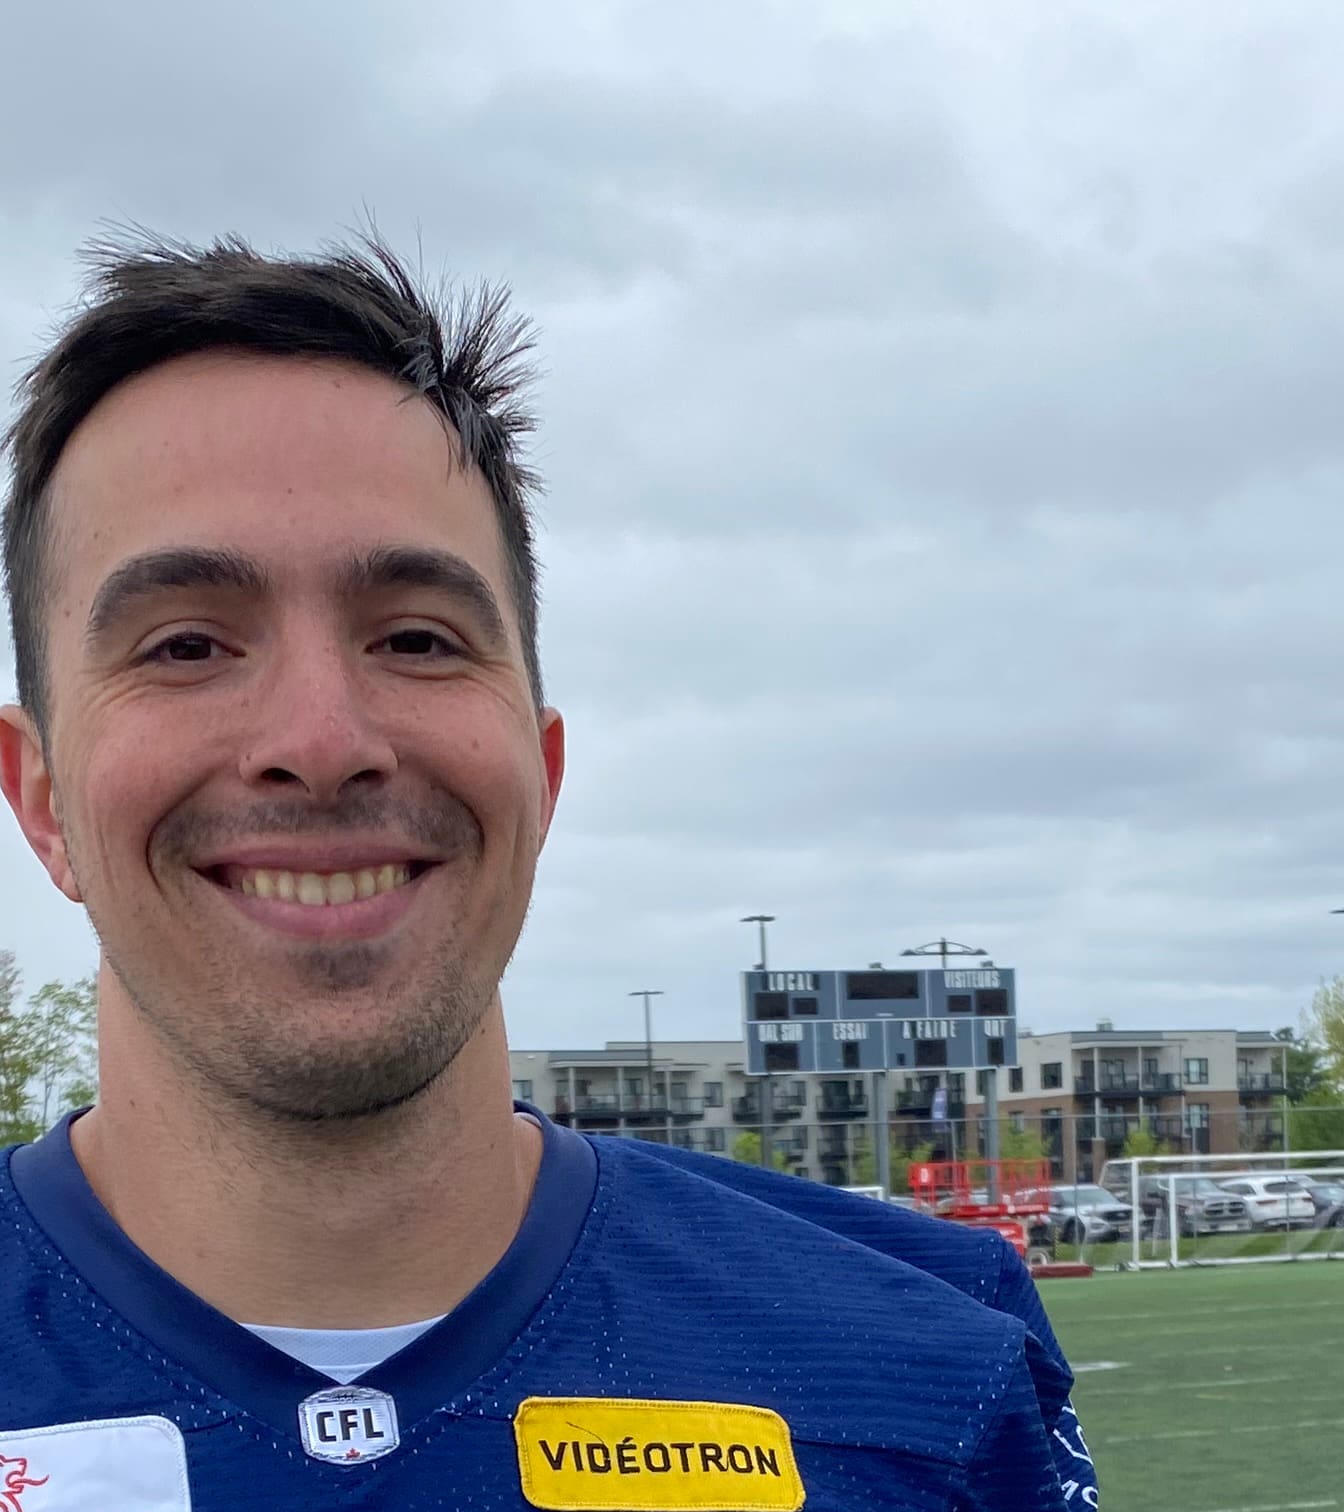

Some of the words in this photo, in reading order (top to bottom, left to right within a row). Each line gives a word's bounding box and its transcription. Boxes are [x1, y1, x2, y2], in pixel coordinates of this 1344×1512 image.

[768, 973, 814, 991] LOCAL
[833, 1022, 867, 1040] ESSAI
[316, 1408, 384, 1442] CFL
[537, 1437, 781, 1478] VIDÉOTRON
